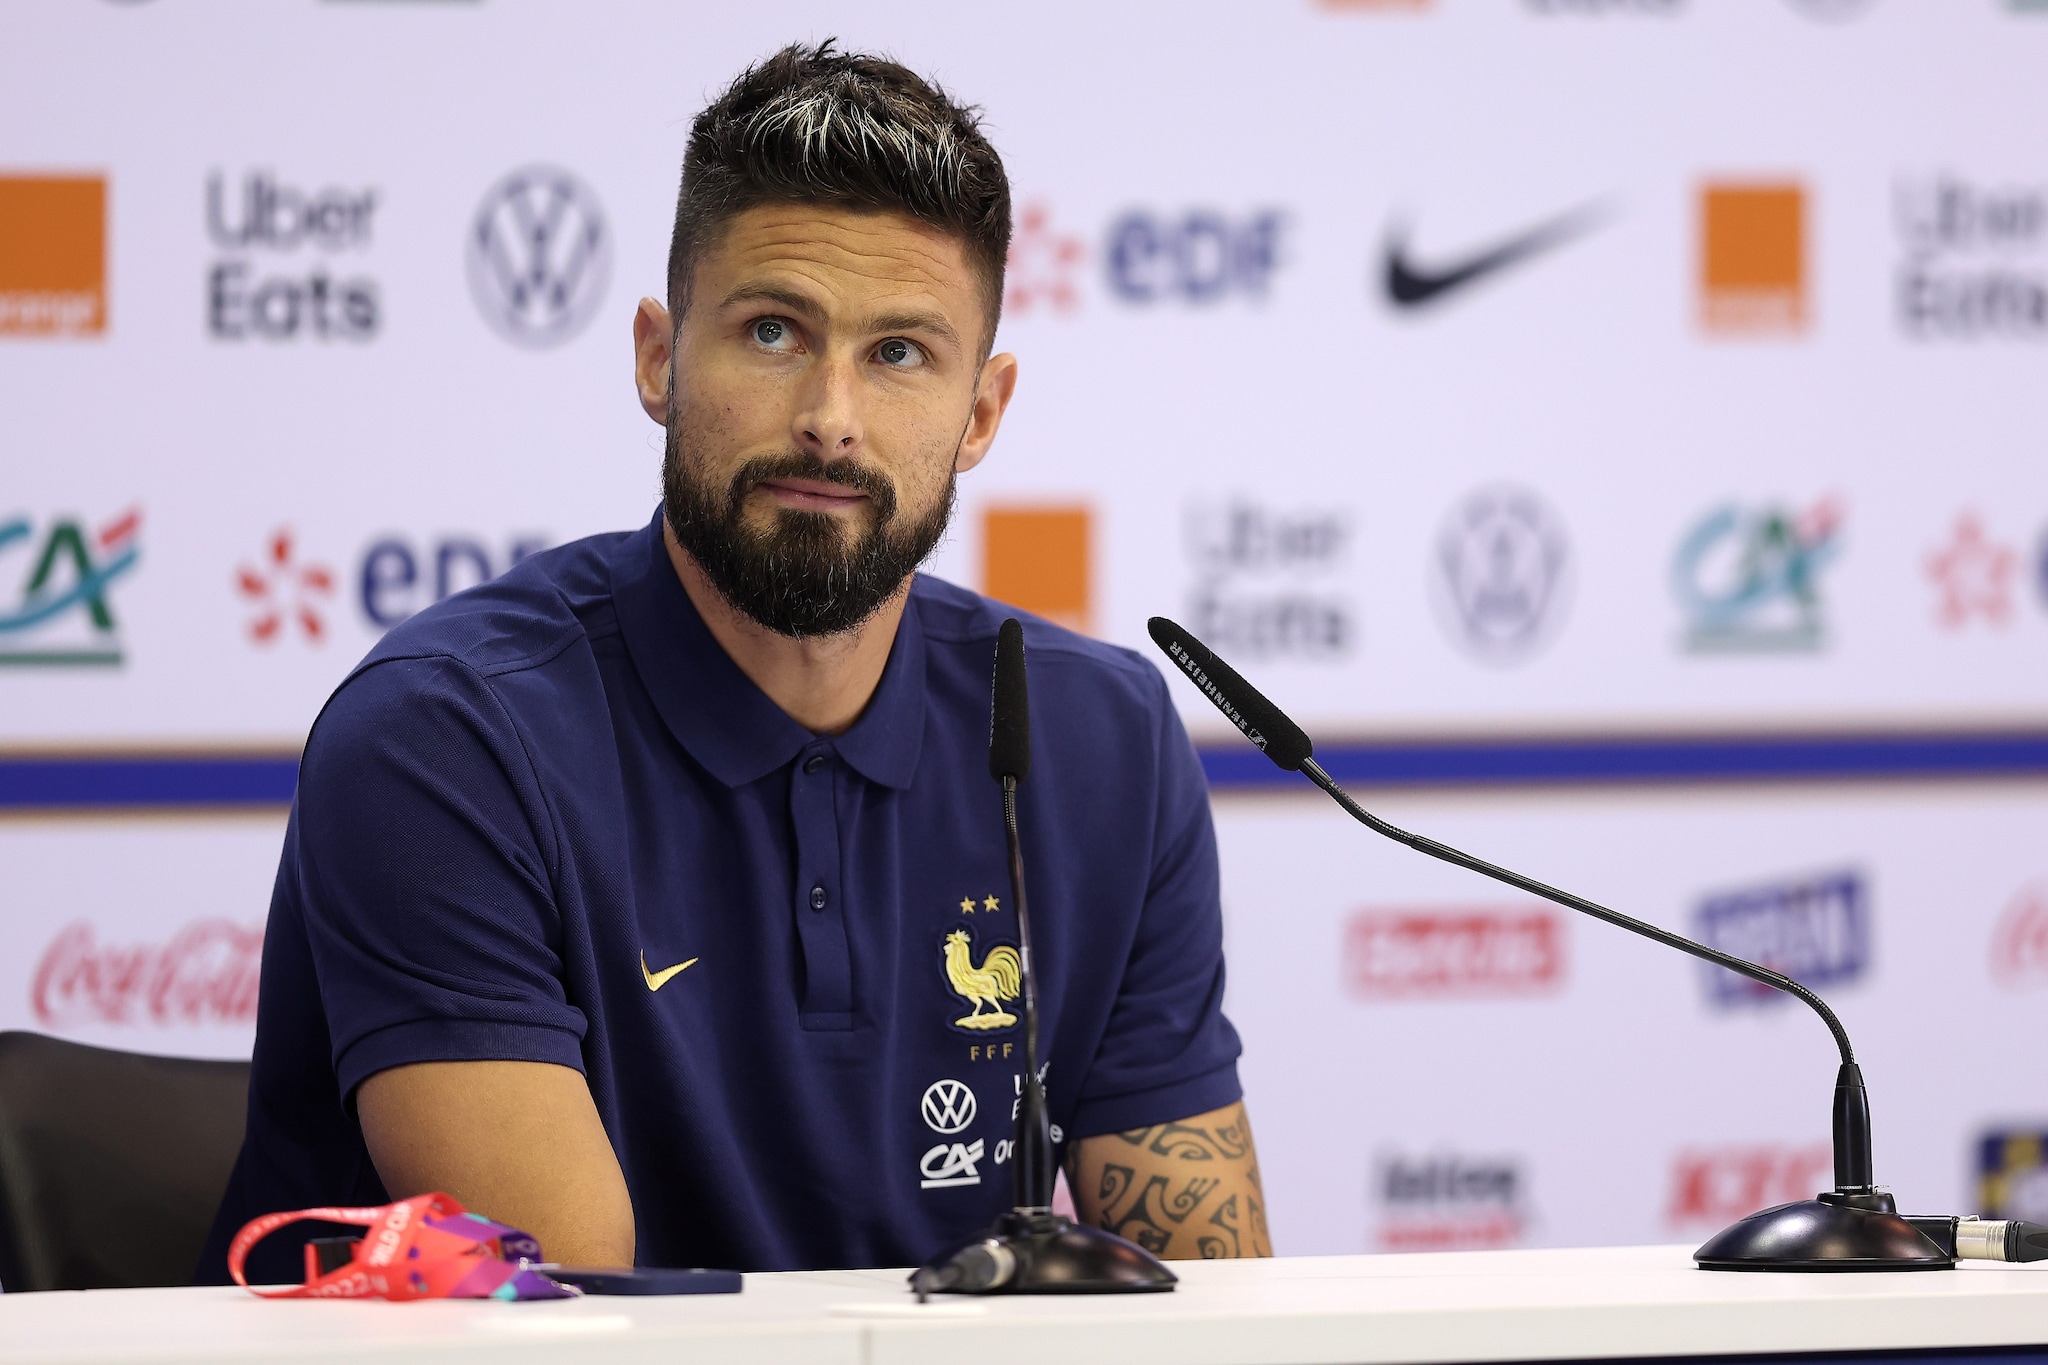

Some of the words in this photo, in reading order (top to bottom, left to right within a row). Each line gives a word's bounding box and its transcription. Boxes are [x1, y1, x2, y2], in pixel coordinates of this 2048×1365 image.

[205, 167, 377, 248] Uber
[208, 263, 381, 339] Eats
[1169, 641, 1249, 730] SENNHEISER
